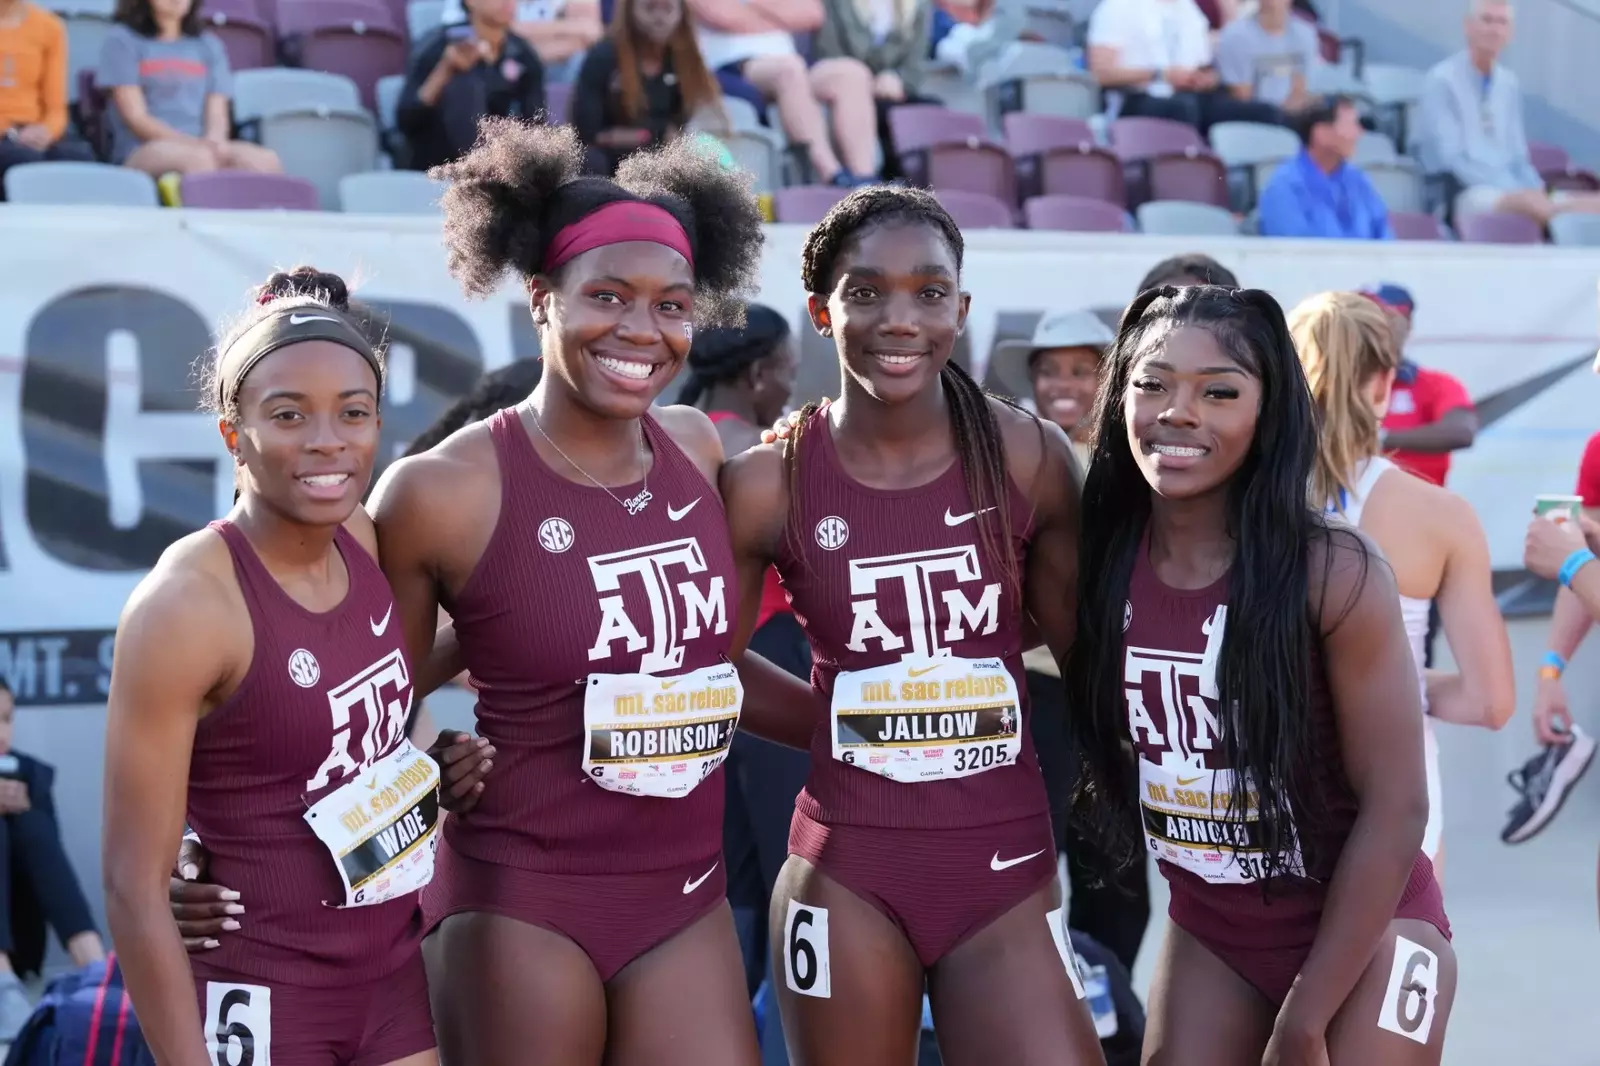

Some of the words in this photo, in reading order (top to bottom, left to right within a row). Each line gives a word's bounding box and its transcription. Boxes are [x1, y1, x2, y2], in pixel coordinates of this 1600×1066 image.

[540, 519, 573, 551] SEC
[817, 518, 847, 549] SEC
[291, 650, 318, 686] SEC
[615, 692, 649, 716] mt.
[653, 691, 687, 714] sac
[689, 685, 737, 711] relays
[861, 679, 897, 702] mt.
[901, 680, 941, 701] sac
[945, 673, 1008, 699] relays
[610, 723, 724, 757] ROBINSON-
[878, 711, 978, 741] JALLOW
[370, 786, 400, 815] sac
[393, 757, 434, 798] relays
[1174, 787, 1209, 809] sac
[376, 805, 427, 859] WADE
[789, 909, 817, 990] 6
[1396, 950, 1431, 1033] 6
[216, 989, 255, 1066] 6
